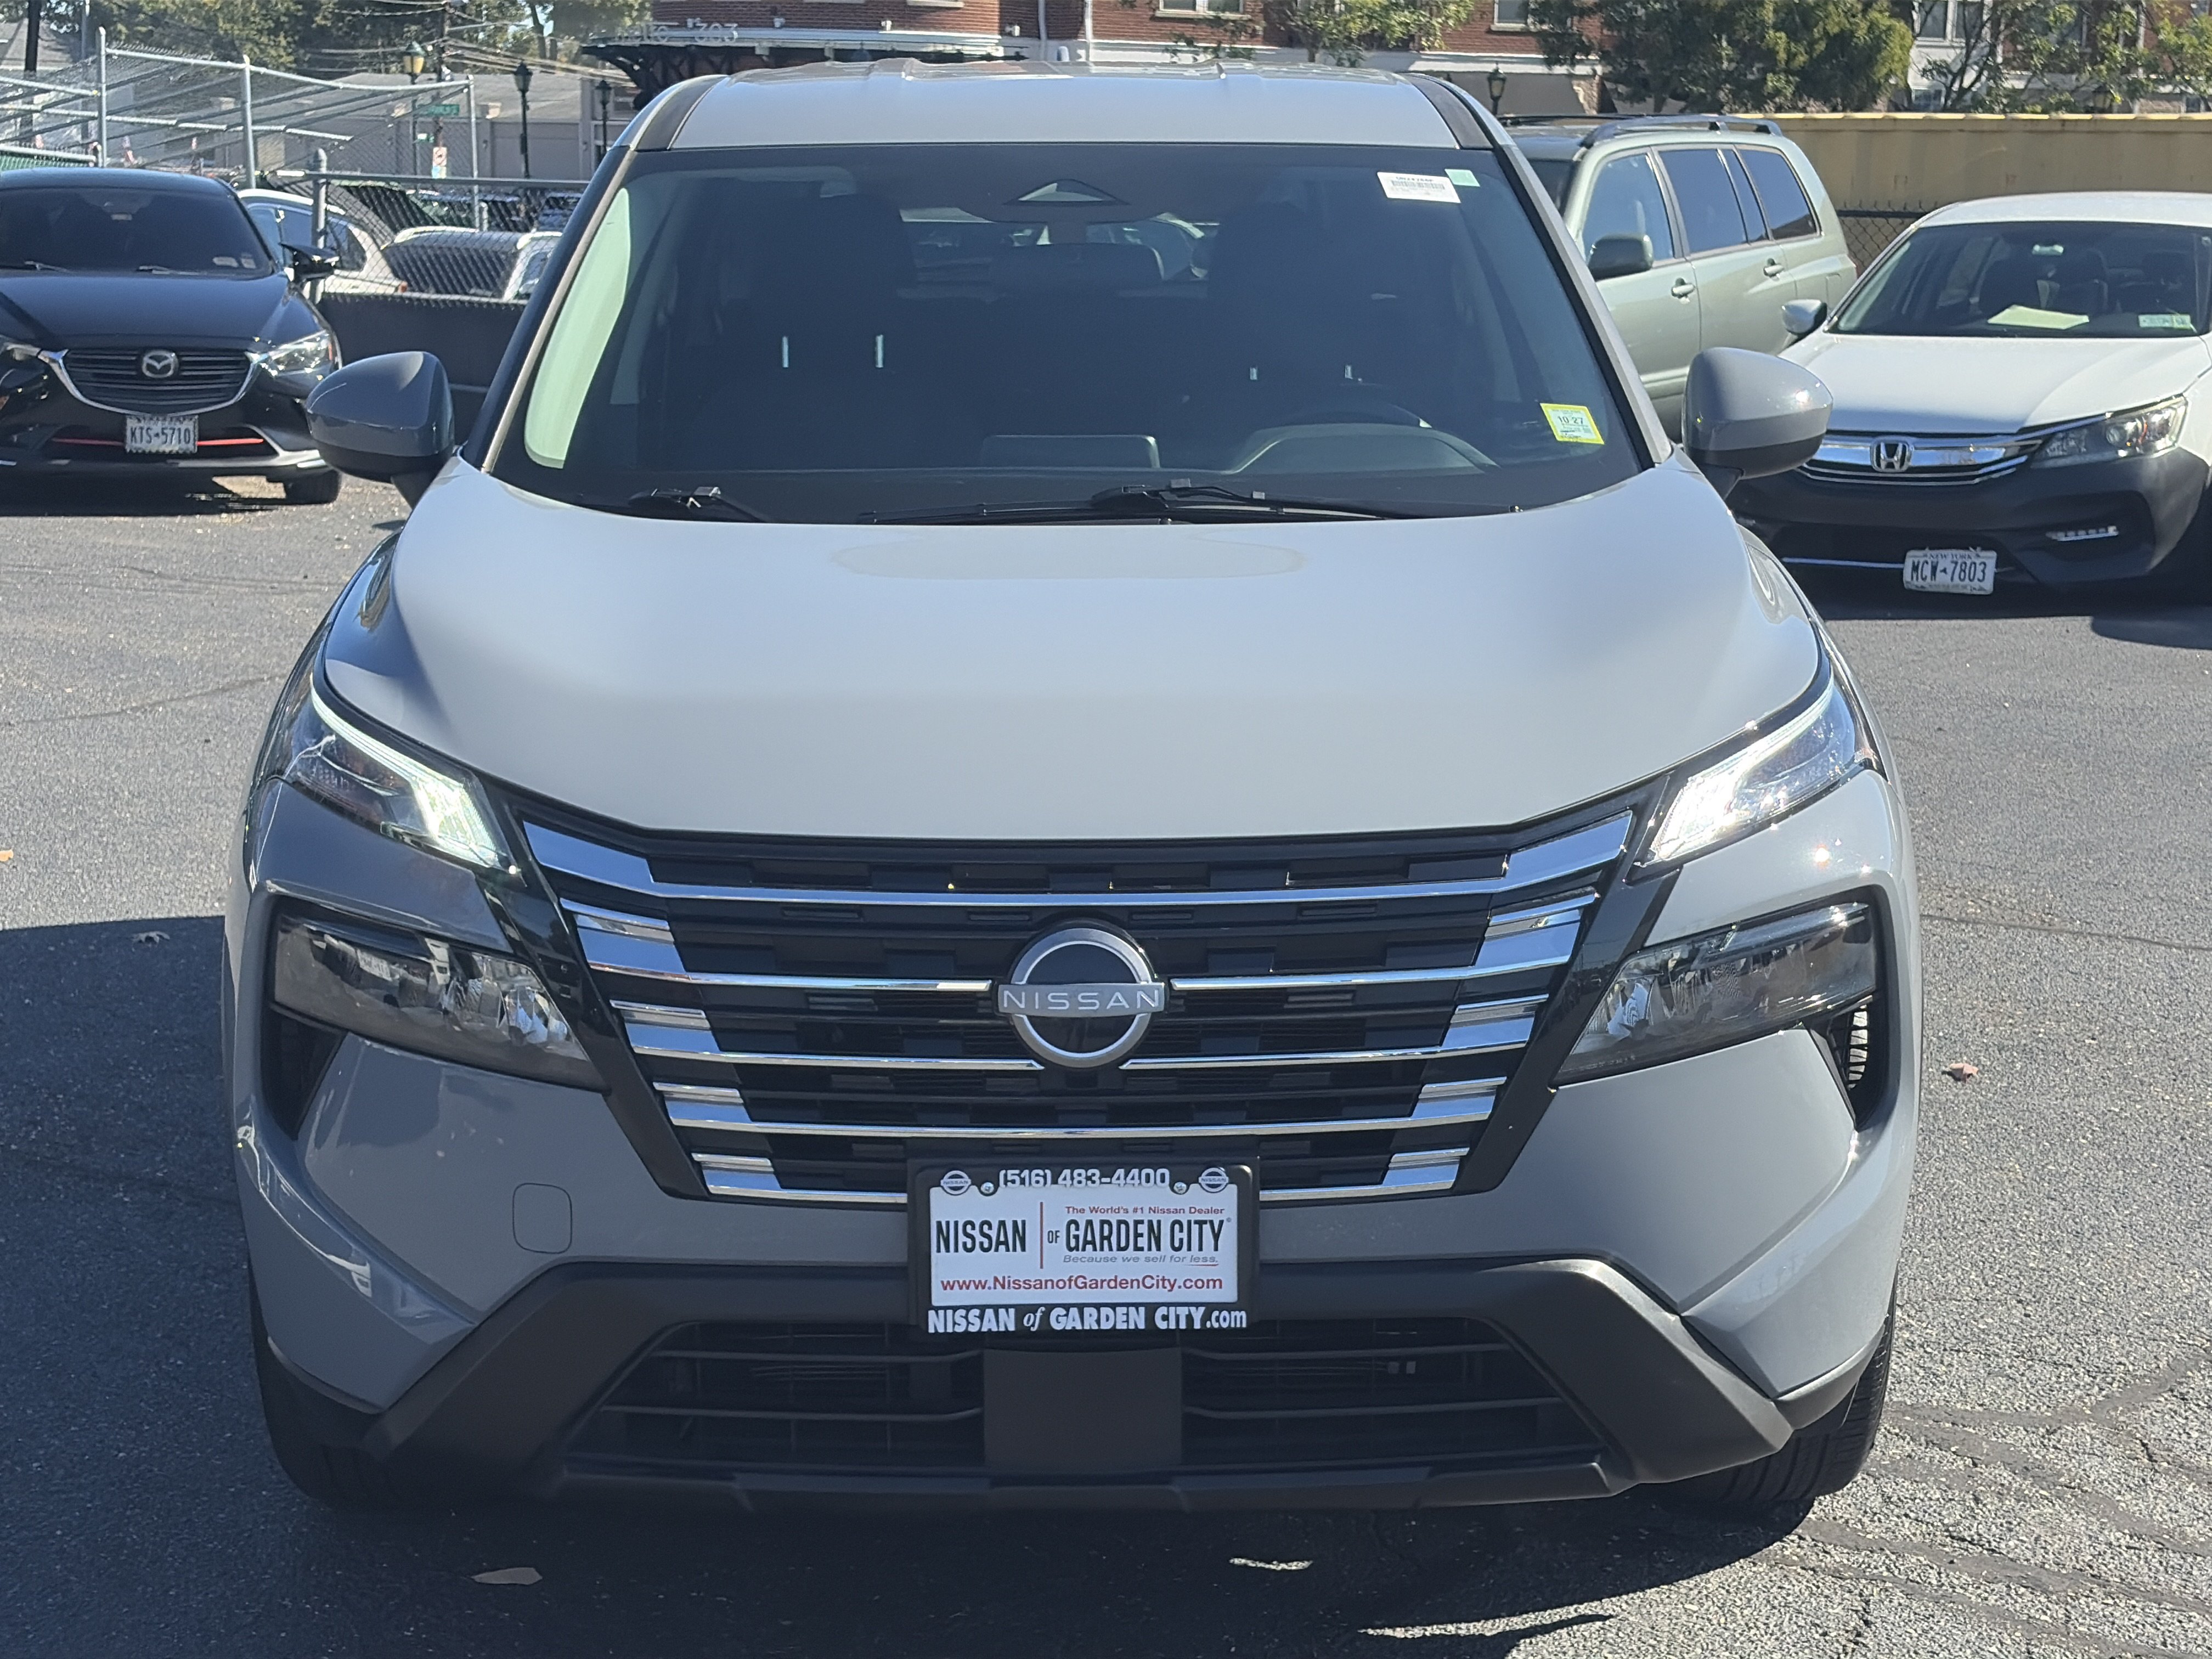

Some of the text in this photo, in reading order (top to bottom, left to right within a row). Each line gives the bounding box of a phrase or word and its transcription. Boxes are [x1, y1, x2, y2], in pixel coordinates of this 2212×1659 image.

[1003, 989, 1159, 1010] NISSAN
[998, 1167, 1170, 1188] (516) 483-4400
[1065, 1206, 1224, 1214] The World's #1 Nissan Dealer
[935, 1219, 1224, 1253] NISSAN OF GARDEN CITY
[1063, 1255, 1118, 1263] Because
[1144, 1255, 1166, 1263] sell
[1169, 1255, 1187, 1263] for
[940, 1274, 1223, 1293] www.NissanofGardenCity.com
[928, 1306, 1247, 1333] NISSAN of GARDEN CITY.com
